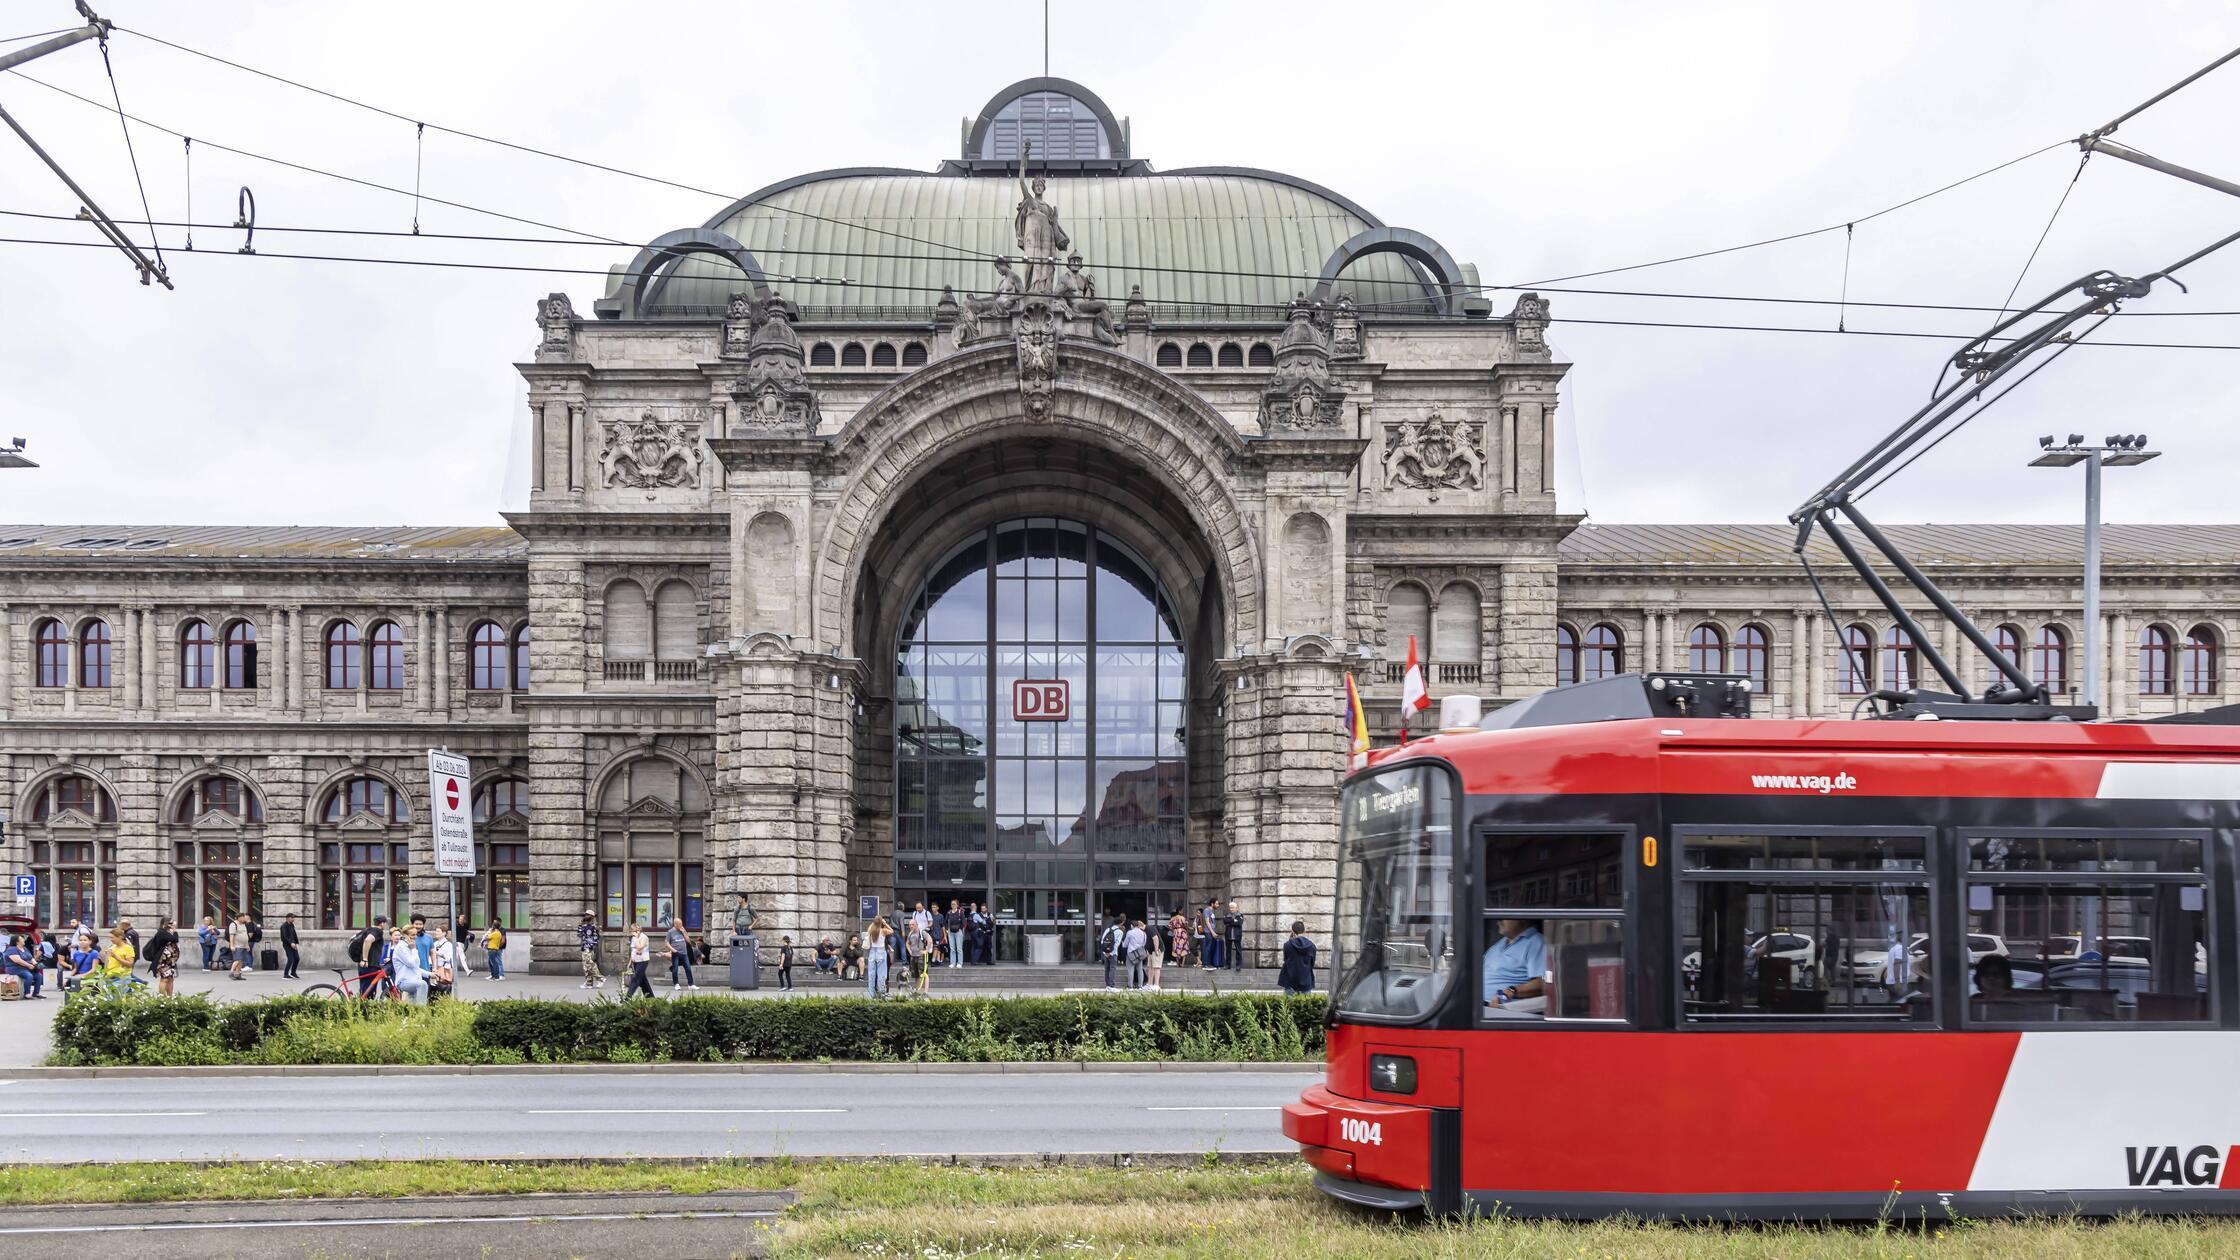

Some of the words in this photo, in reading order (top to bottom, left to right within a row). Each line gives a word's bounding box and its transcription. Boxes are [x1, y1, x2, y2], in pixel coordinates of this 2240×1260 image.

[1021, 687, 1064, 714] DB
[1751, 771, 1857, 794] www.vag.de
[20, 877, 32, 894] P
[1340, 1117, 1383, 1146] 1004
[2124, 1145, 2221, 1186] VAG
